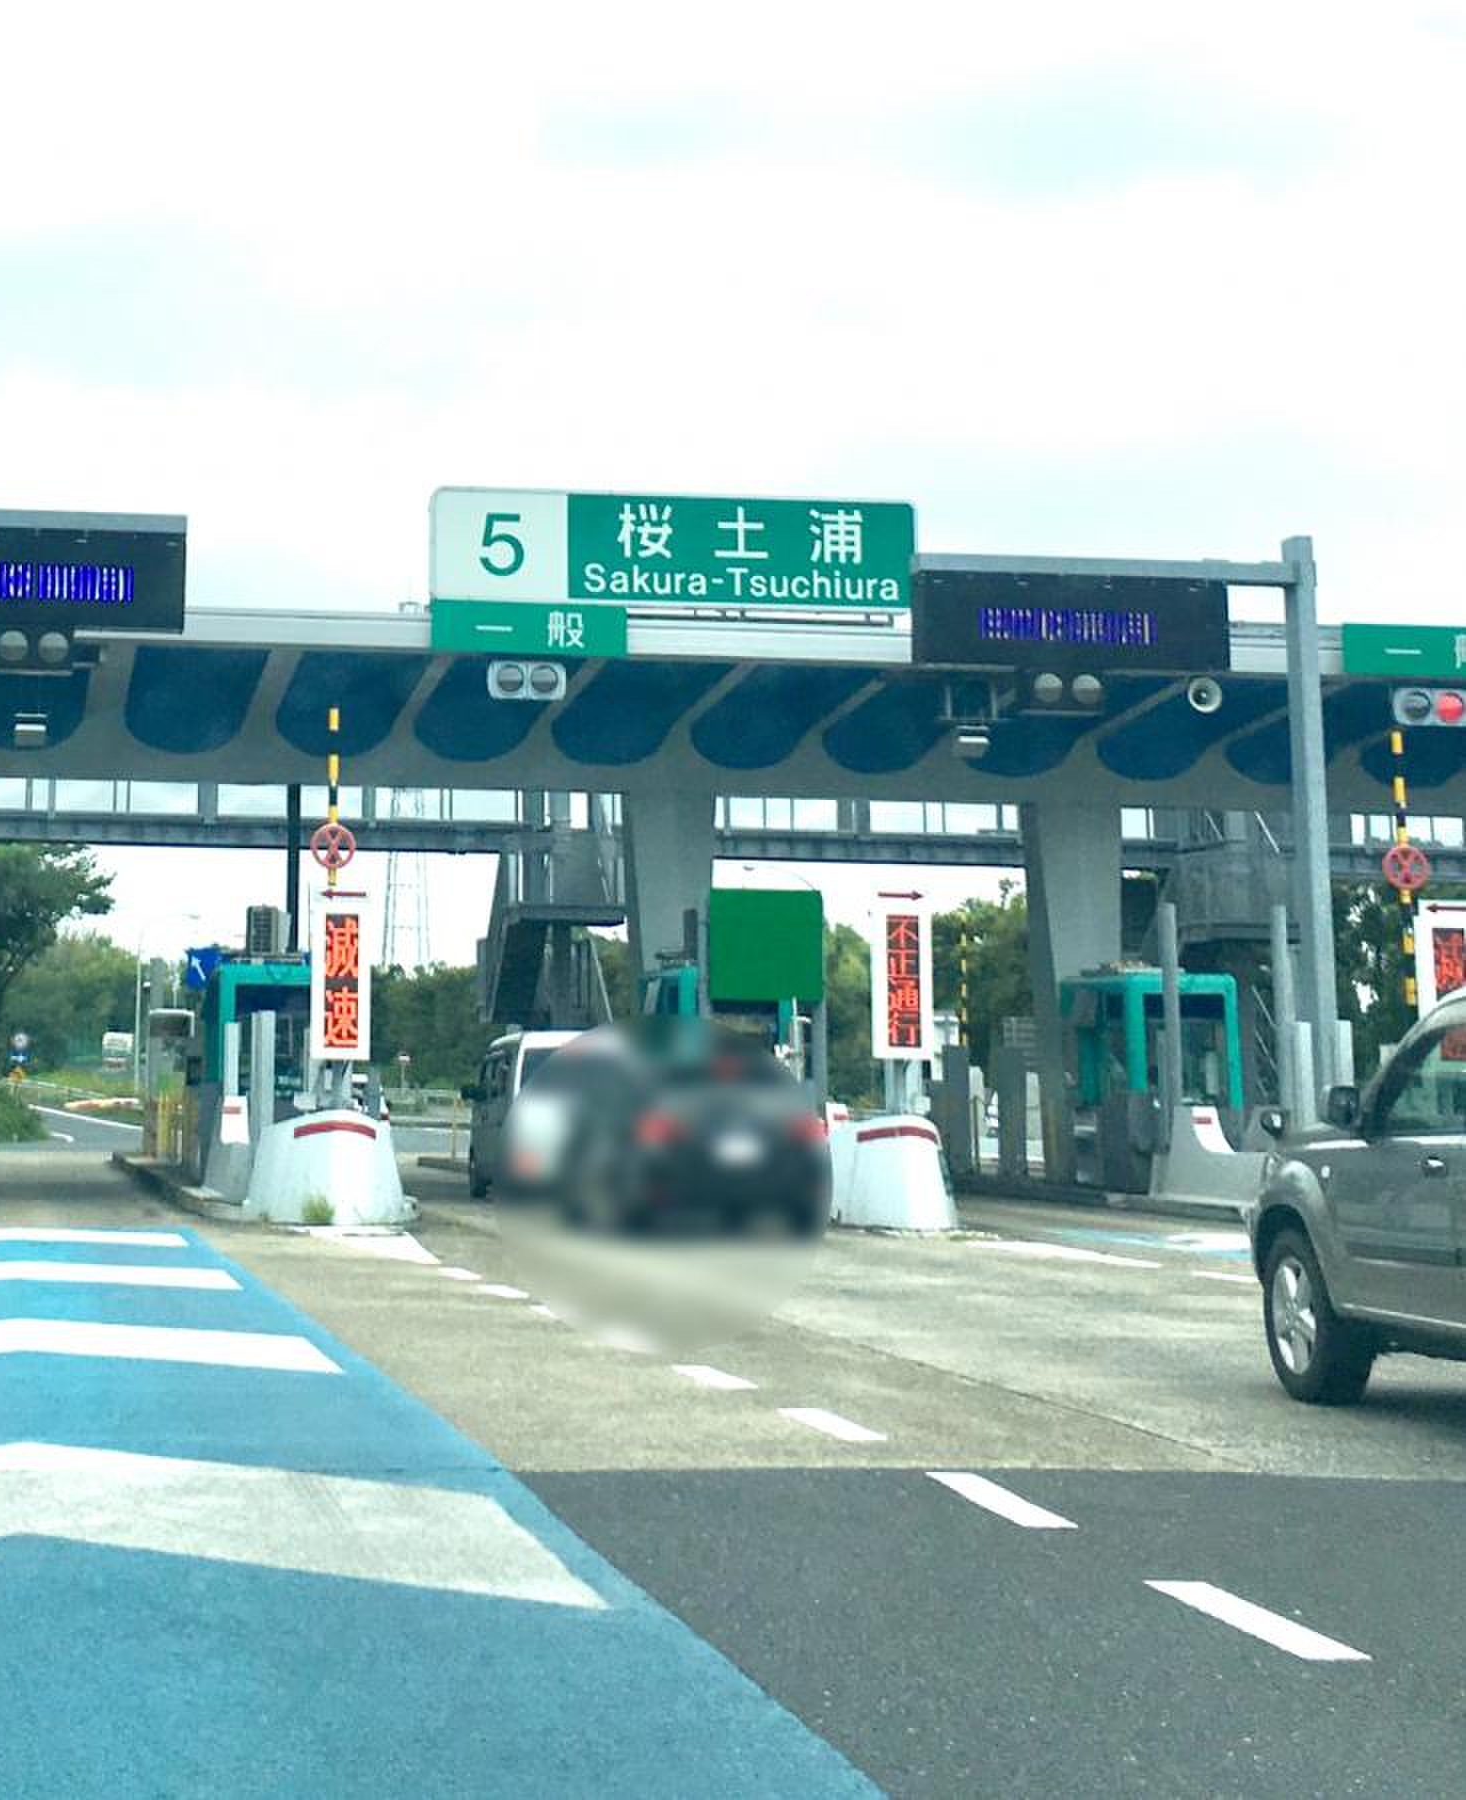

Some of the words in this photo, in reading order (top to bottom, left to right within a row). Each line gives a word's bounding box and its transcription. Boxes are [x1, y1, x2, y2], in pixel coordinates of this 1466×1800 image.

[478, 512, 525, 577] 5
[617, 503, 864, 565] 桜土浦
[583, 563, 901, 602] Sakura-Tsuchiura
[474, 610, 586, 650] 一般
[324, 916, 359, 1047] 減速
[886, 915, 922, 1047] 不正通行
